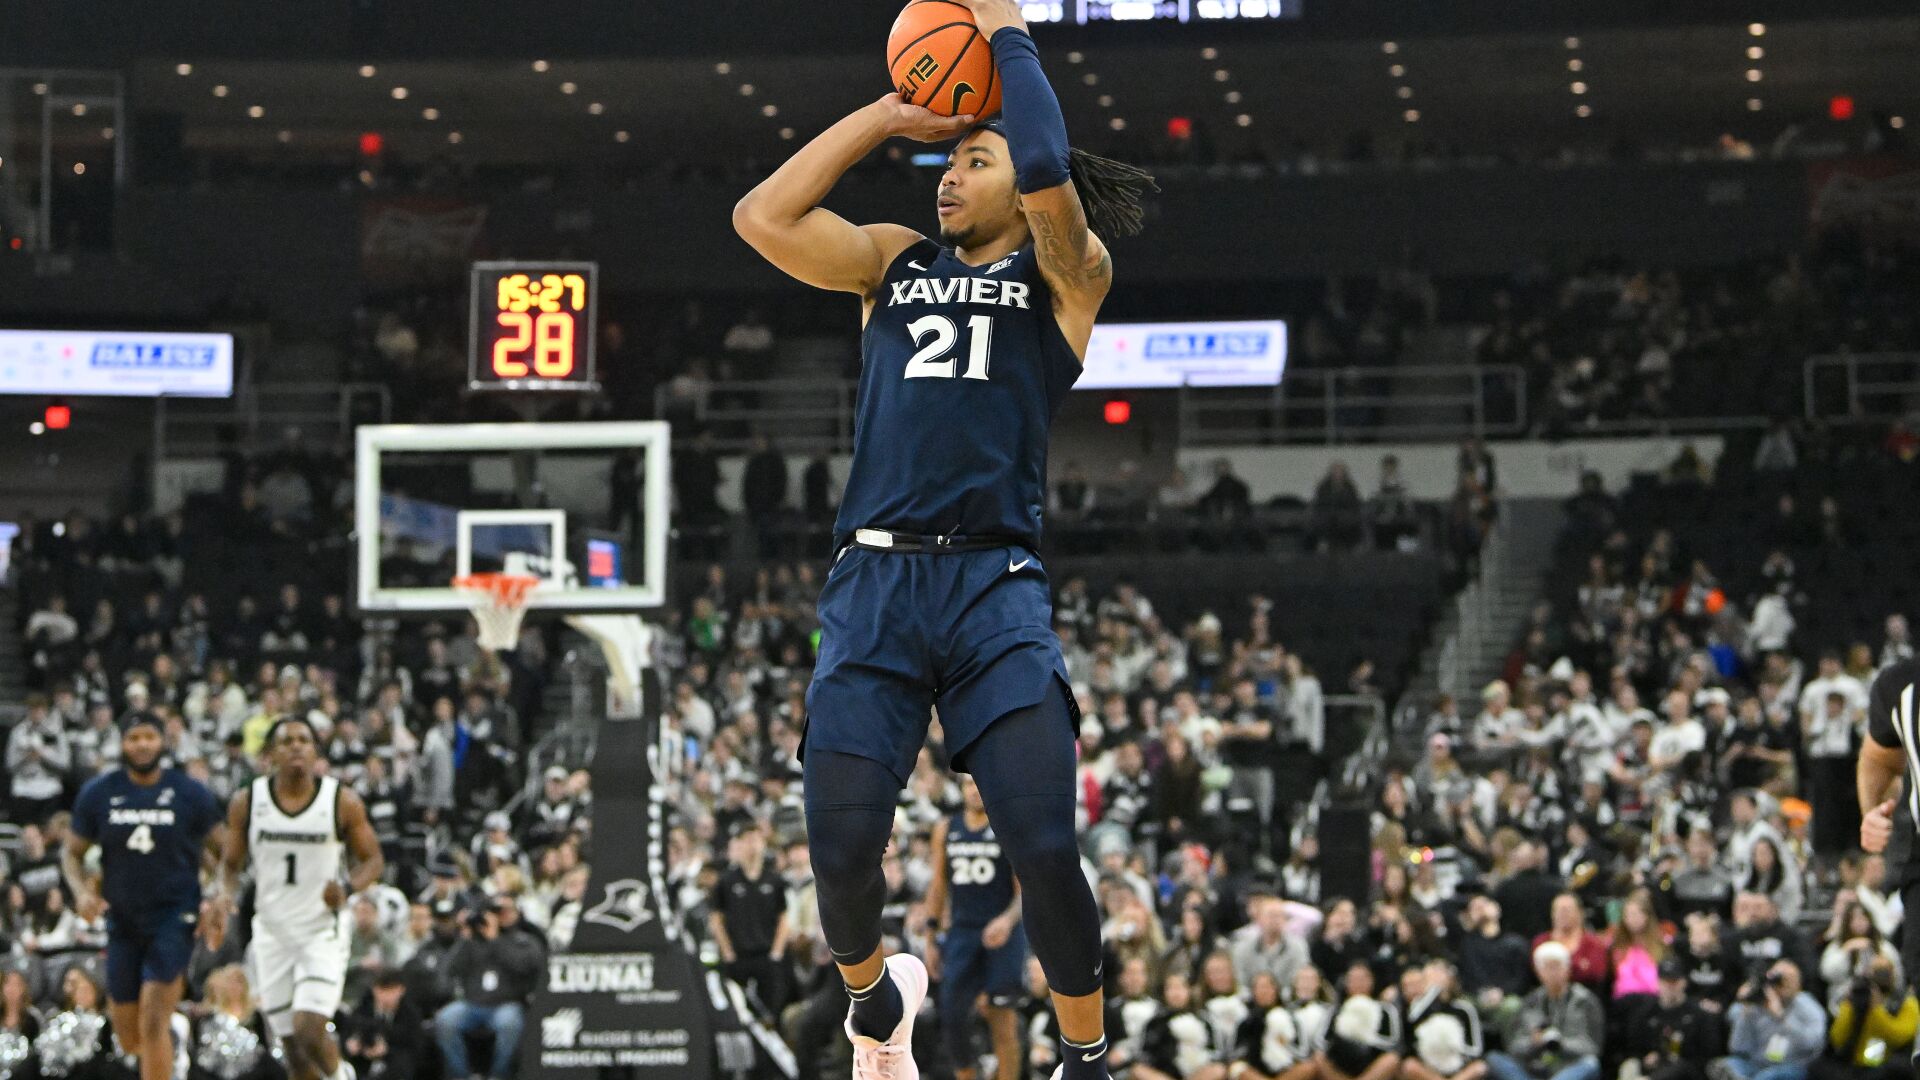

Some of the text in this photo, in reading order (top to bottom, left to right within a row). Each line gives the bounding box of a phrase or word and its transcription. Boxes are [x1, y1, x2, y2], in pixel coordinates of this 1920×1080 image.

[497, 273, 586, 314] 15:27
[887, 276, 1031, 310] XAVIER
[493, 311, 575, 377] 28
[904, 314, 995, 381] 21
[125, 824, 156, 855] 4
[284, 853, 298, 886] 1
[951, 855, 997, 886] 20
[547, 963, 655, 993] LIUNA!
